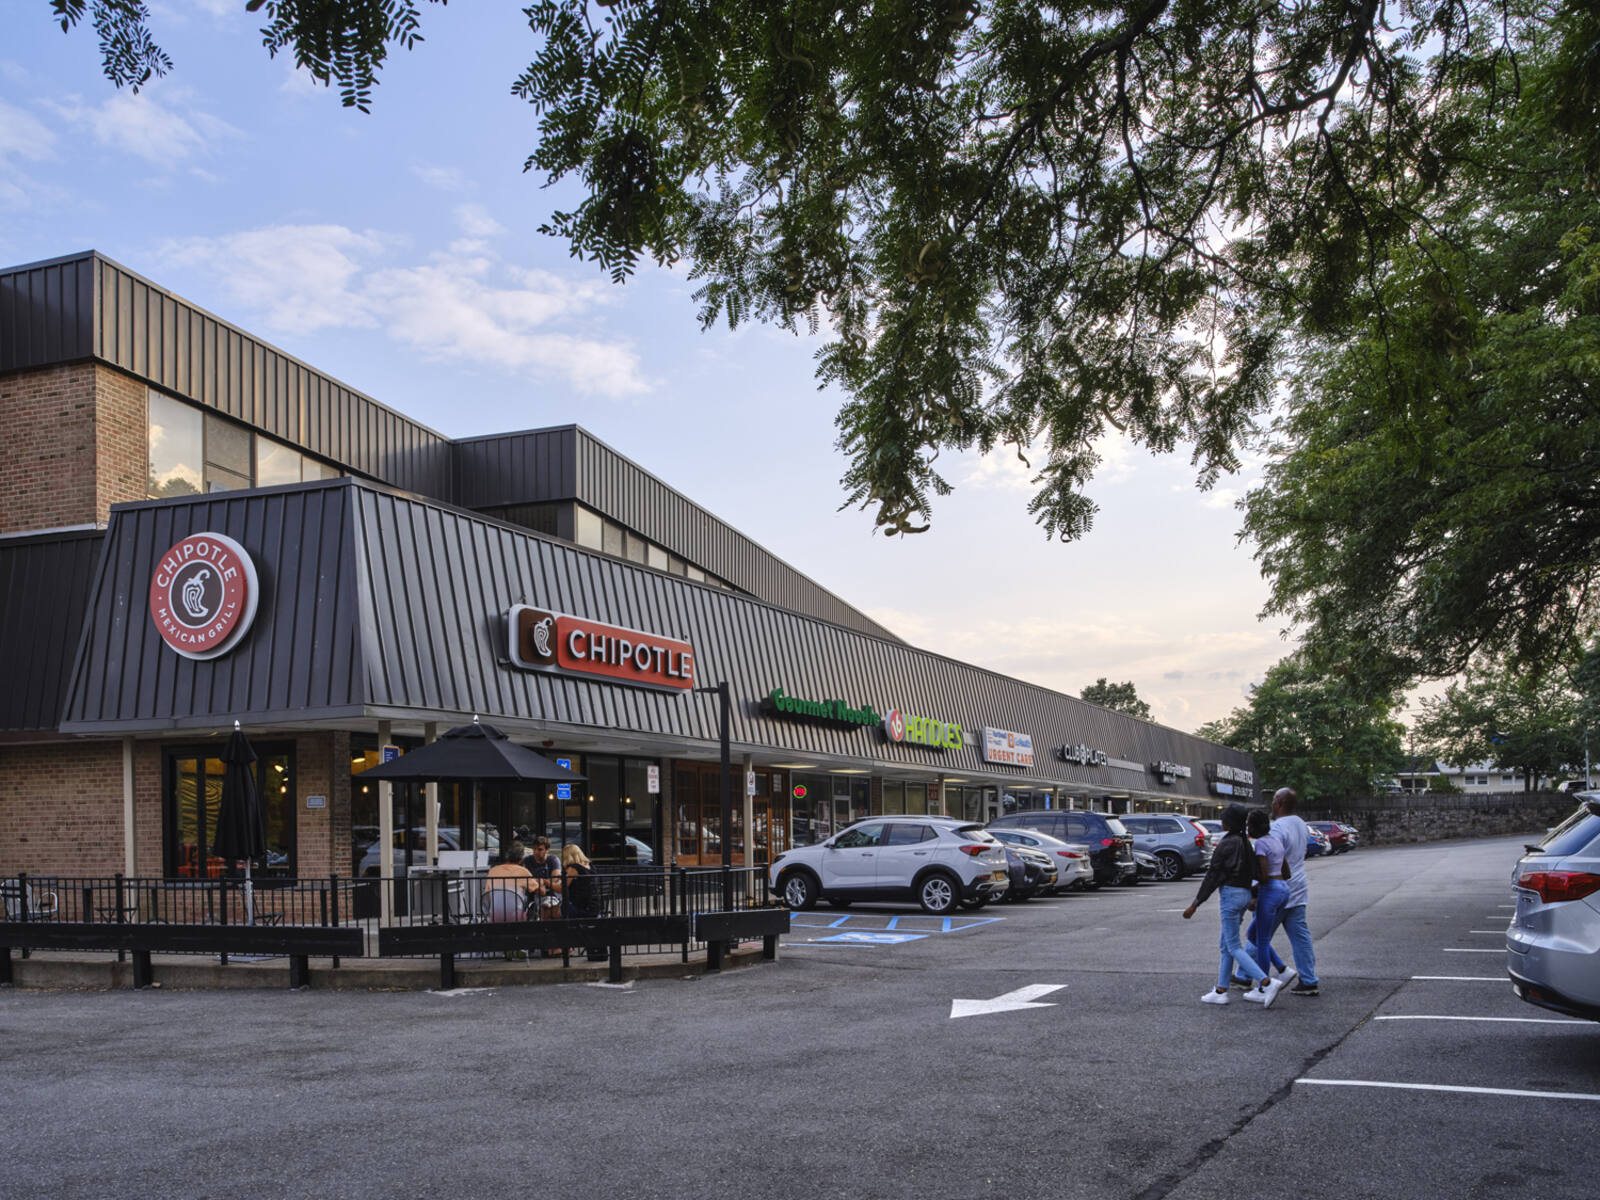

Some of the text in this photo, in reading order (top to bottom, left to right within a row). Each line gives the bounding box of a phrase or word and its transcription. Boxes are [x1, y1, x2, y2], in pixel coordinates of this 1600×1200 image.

[157, 542, 237, 587] CHIPOTLE
[158, 602, 236, 643] MEXICAN GRILL
[569, 629, 692, 678] CHIPOTLE
[770, 688, 880, 727] Gourmet Noodle
[905, 713, 962, 750] HANDLES
[988, 748, 1033, 765] URGENT CARE
